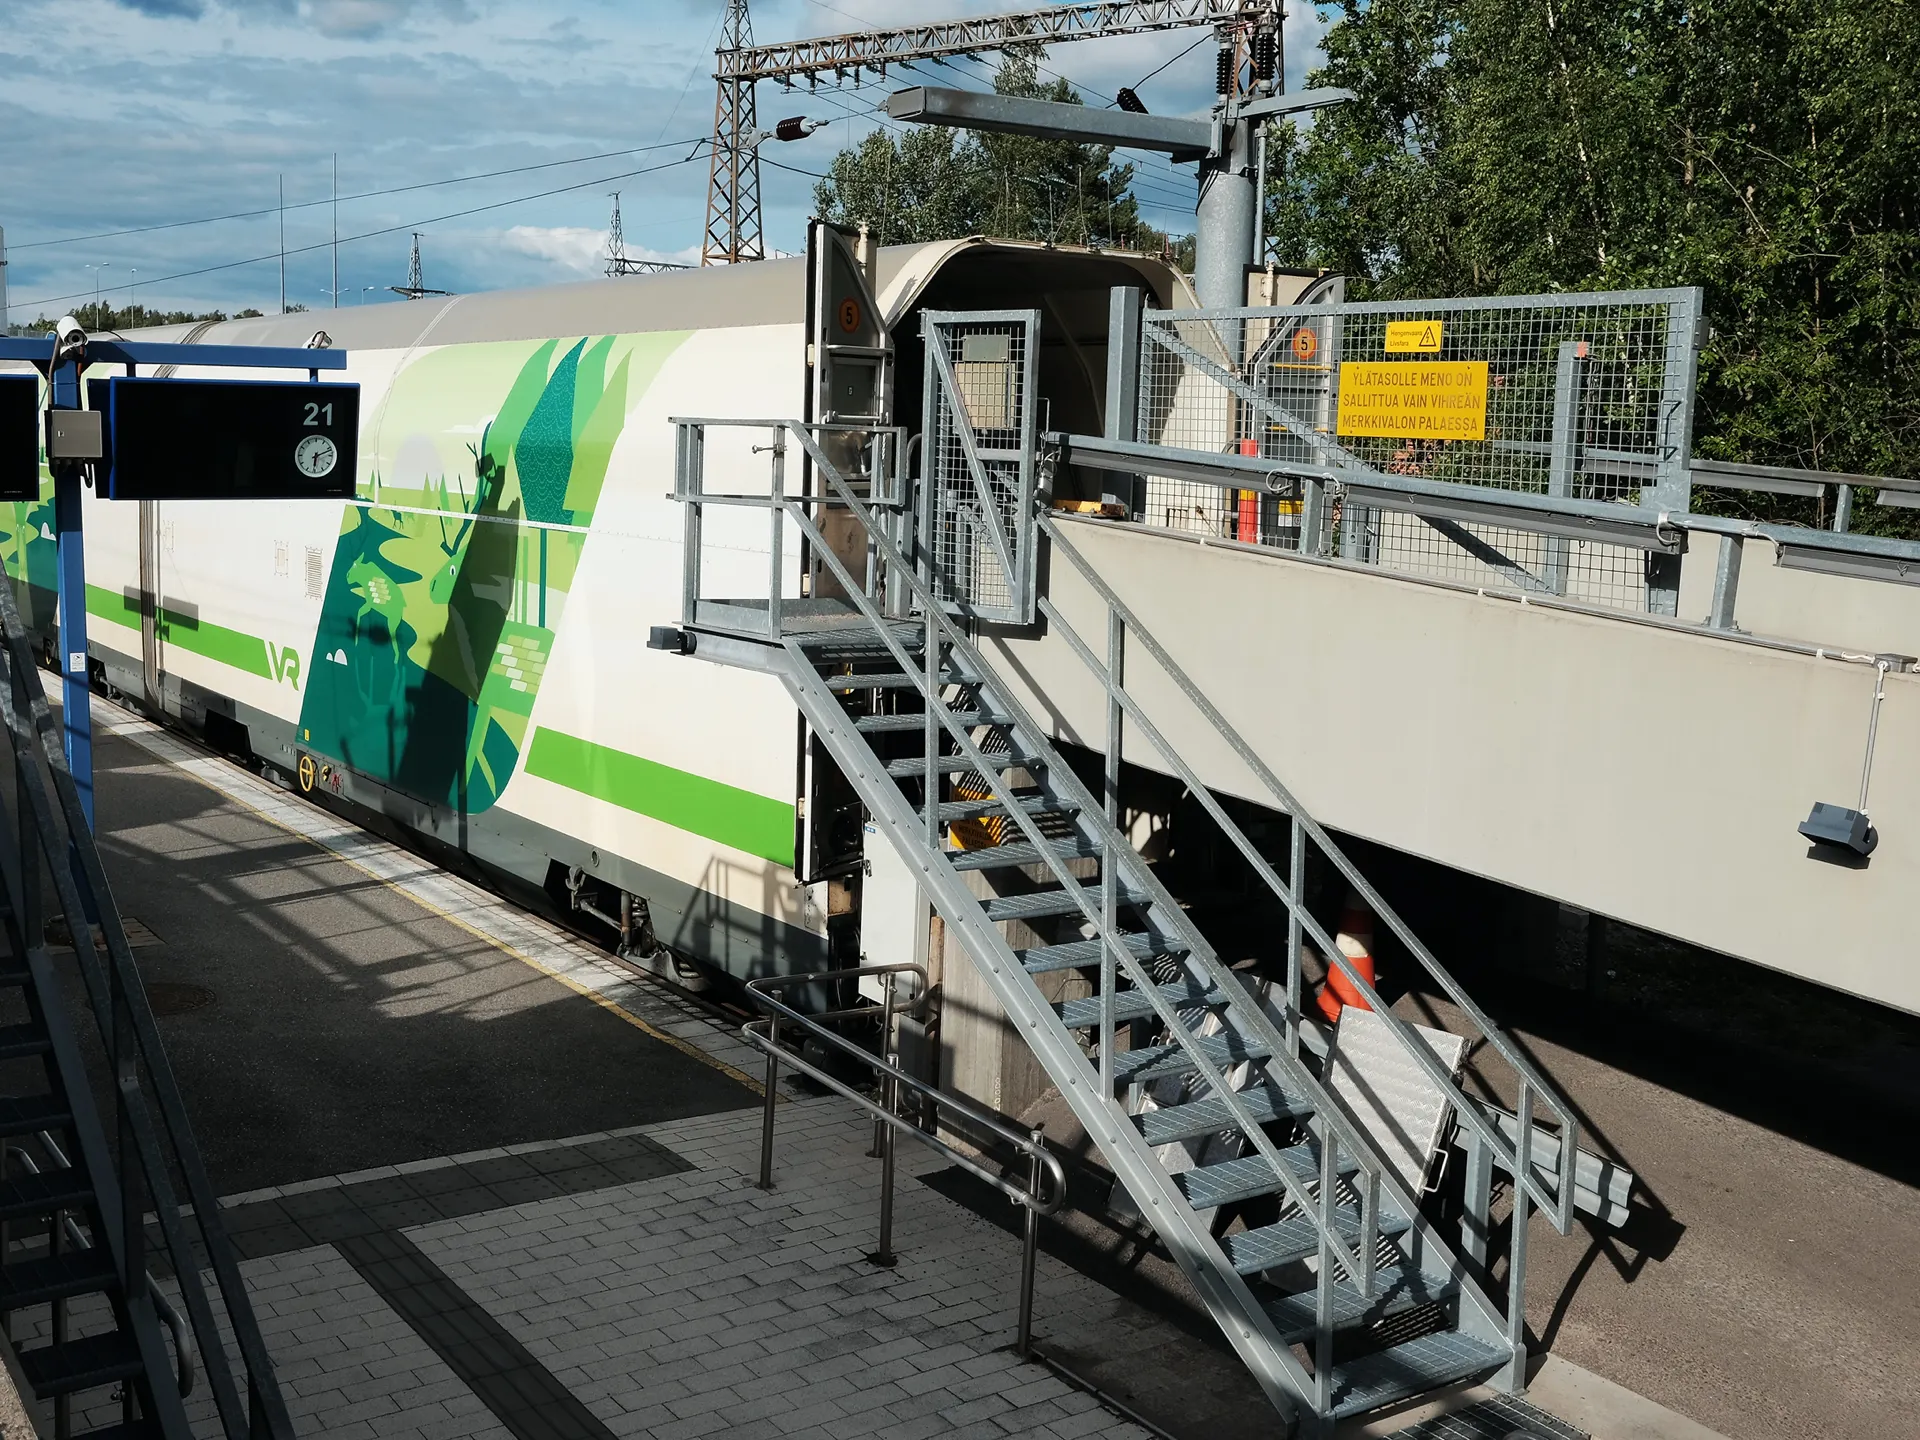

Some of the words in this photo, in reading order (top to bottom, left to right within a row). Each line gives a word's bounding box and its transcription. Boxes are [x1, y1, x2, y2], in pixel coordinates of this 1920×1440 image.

[846, 306, 852, 325] 5
[1301, 336, 1308, 351] 5
[1353, 370, 1417, 386] YLÄTASOLLE
[1420, 372, 1453, 386] MENO
[1456, 372, 1473, 387] ON
[1343, 393, 1399, 407] SALLITTUA
[1403, 394, 1428, 408] VAIN
[1431, 392, 1480, 409] VIHREÄN
[303, 402, 333, 426] 21
[1343, 414, 1416, 429] MERKKIVALON
[1418, 416, 1478, 432] PALAESSA
[269, 641, 300, 691] VR
